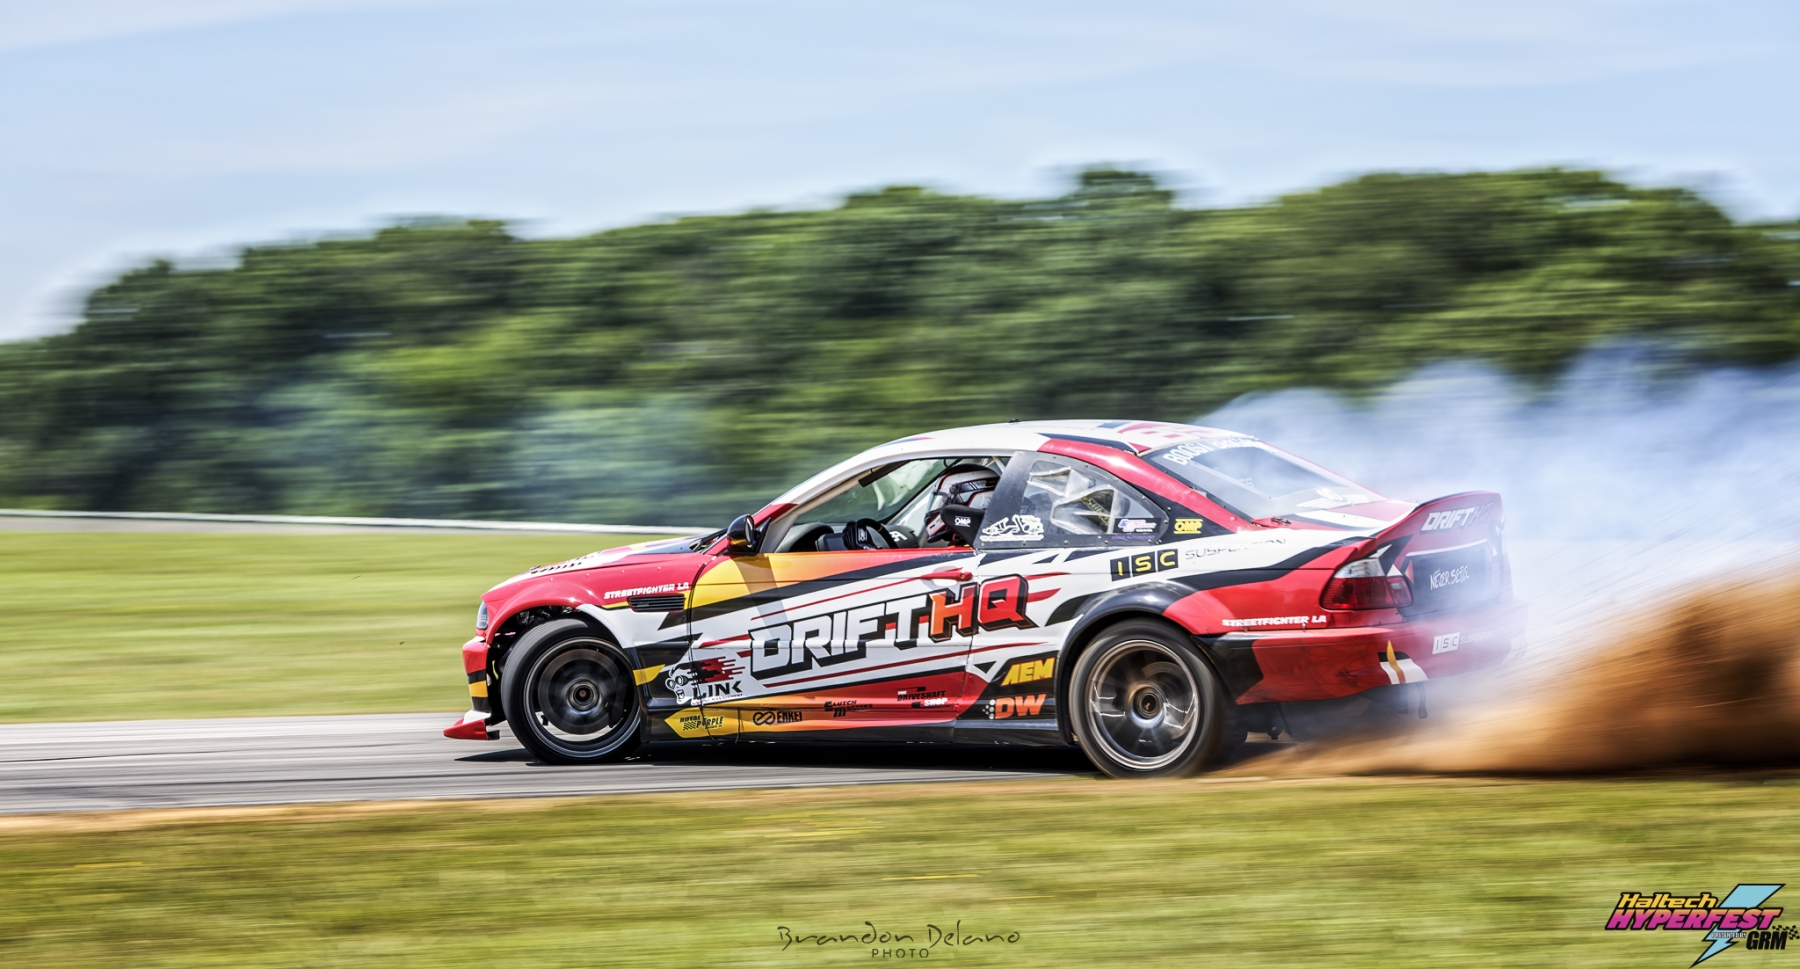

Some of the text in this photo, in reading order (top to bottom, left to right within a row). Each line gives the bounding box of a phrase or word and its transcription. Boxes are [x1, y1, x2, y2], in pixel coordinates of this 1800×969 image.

[1174, 521, 1203, 533] OMP
[1117, 551, 1176, 577] ISC
[603, 581, 690, 600] STREETFIGHTER LA
[1221, 615, 1327, 627] STREETFIGHTER LA
[1001, 657, 1055, 686] AEM
[692, 680, 743, 701] LINK
[897, 690, 947, 702] DRIVESHAFT
[924, 697, 949, 707] SHOP
[994, 693, 1047, 719] DW
[776, 710, 803, 724] ENKEI
